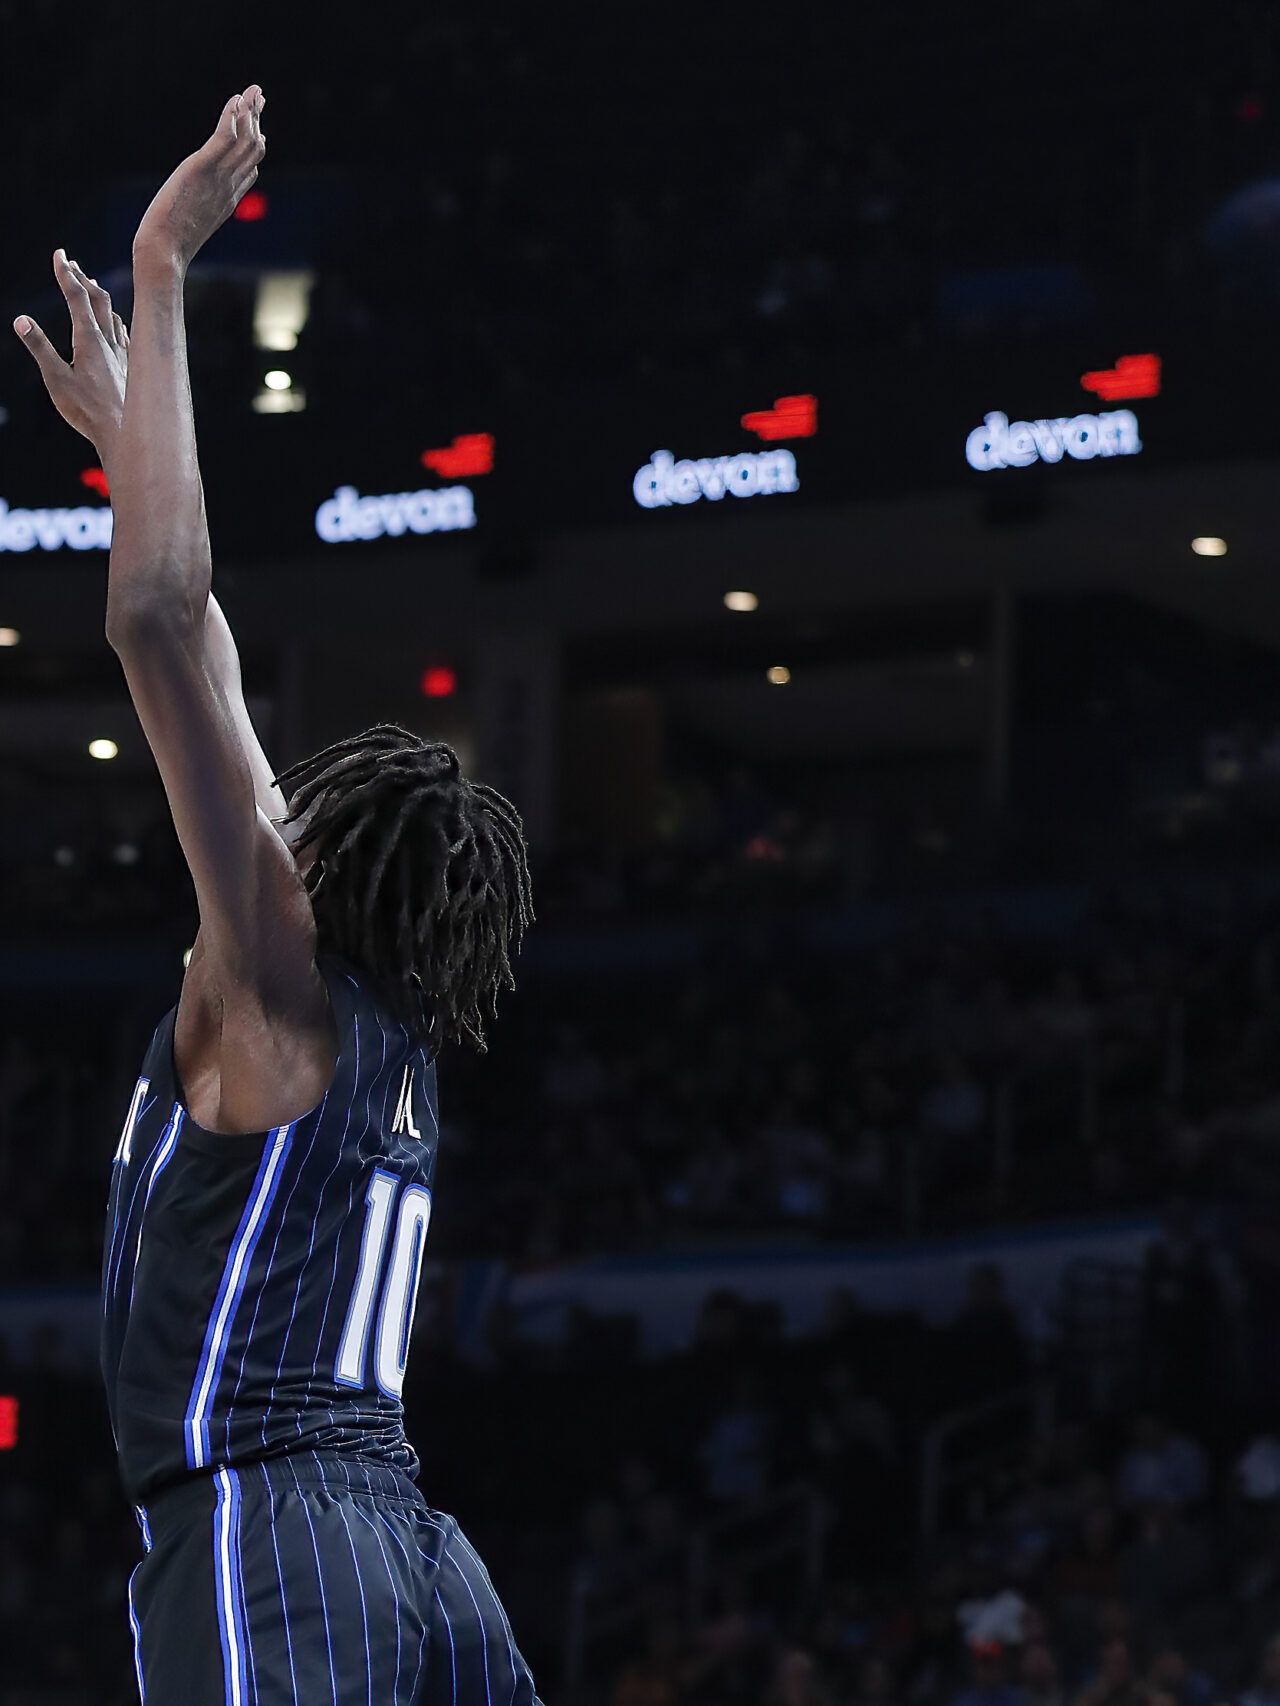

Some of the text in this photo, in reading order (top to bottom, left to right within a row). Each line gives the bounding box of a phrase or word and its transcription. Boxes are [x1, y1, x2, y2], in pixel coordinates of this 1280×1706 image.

[965, 409, 1144, 472] devon
[632, 449, 799, 509] devon
[315, 485, 476, 544] devon
[334, 1167, 432, 1401] 10
